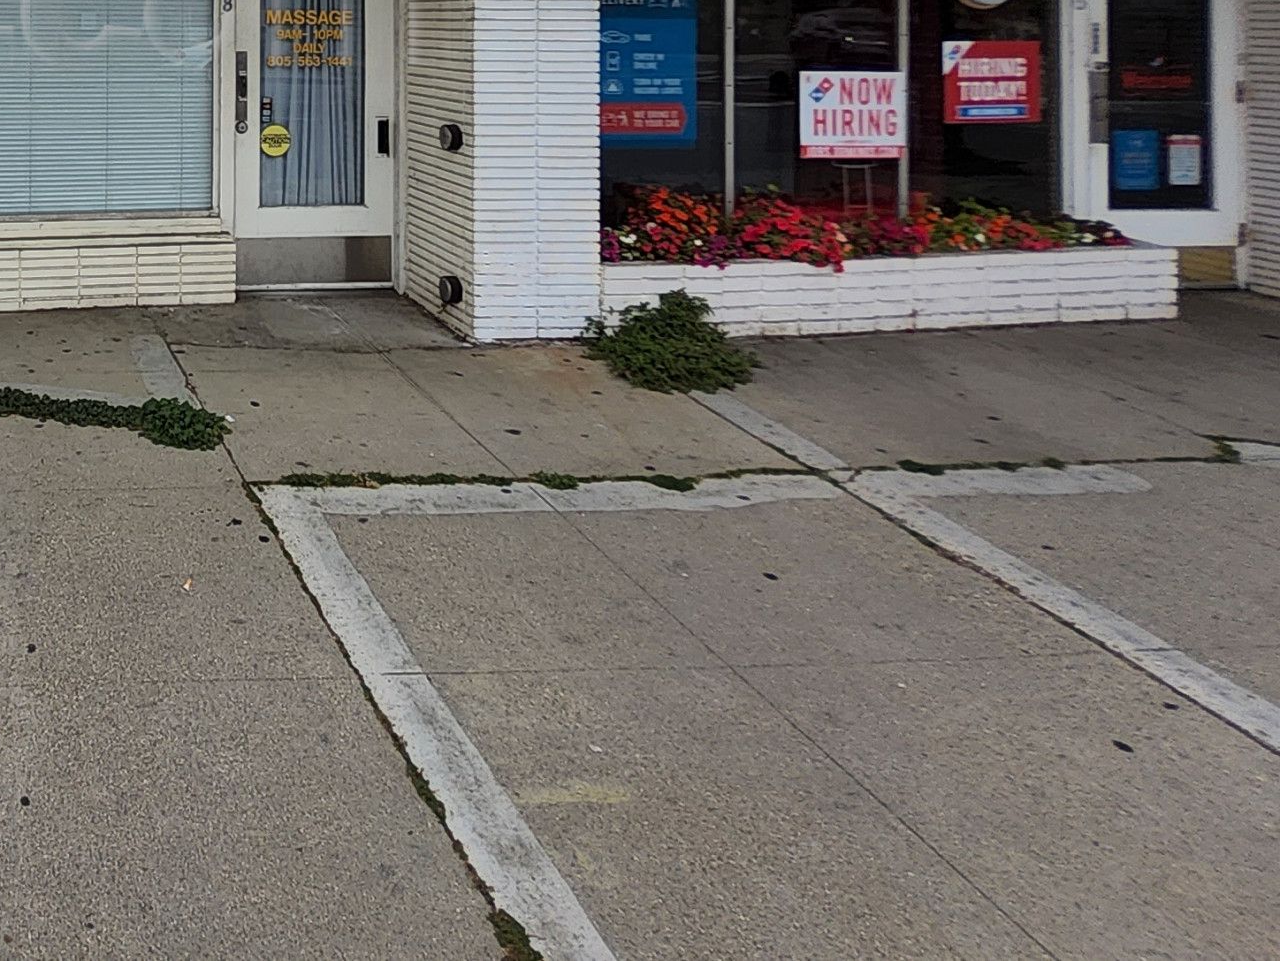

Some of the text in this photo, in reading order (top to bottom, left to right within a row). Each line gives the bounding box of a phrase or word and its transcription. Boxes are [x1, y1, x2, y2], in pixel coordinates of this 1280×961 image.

[266, 10, 353, 25] MASSAGE
[313, 30, 343, 41] 10PM
[293, 43, 326, 54] DAILY
[839, 77, 896, 105] NOW
[813, 109, 898, 136] HIRING
